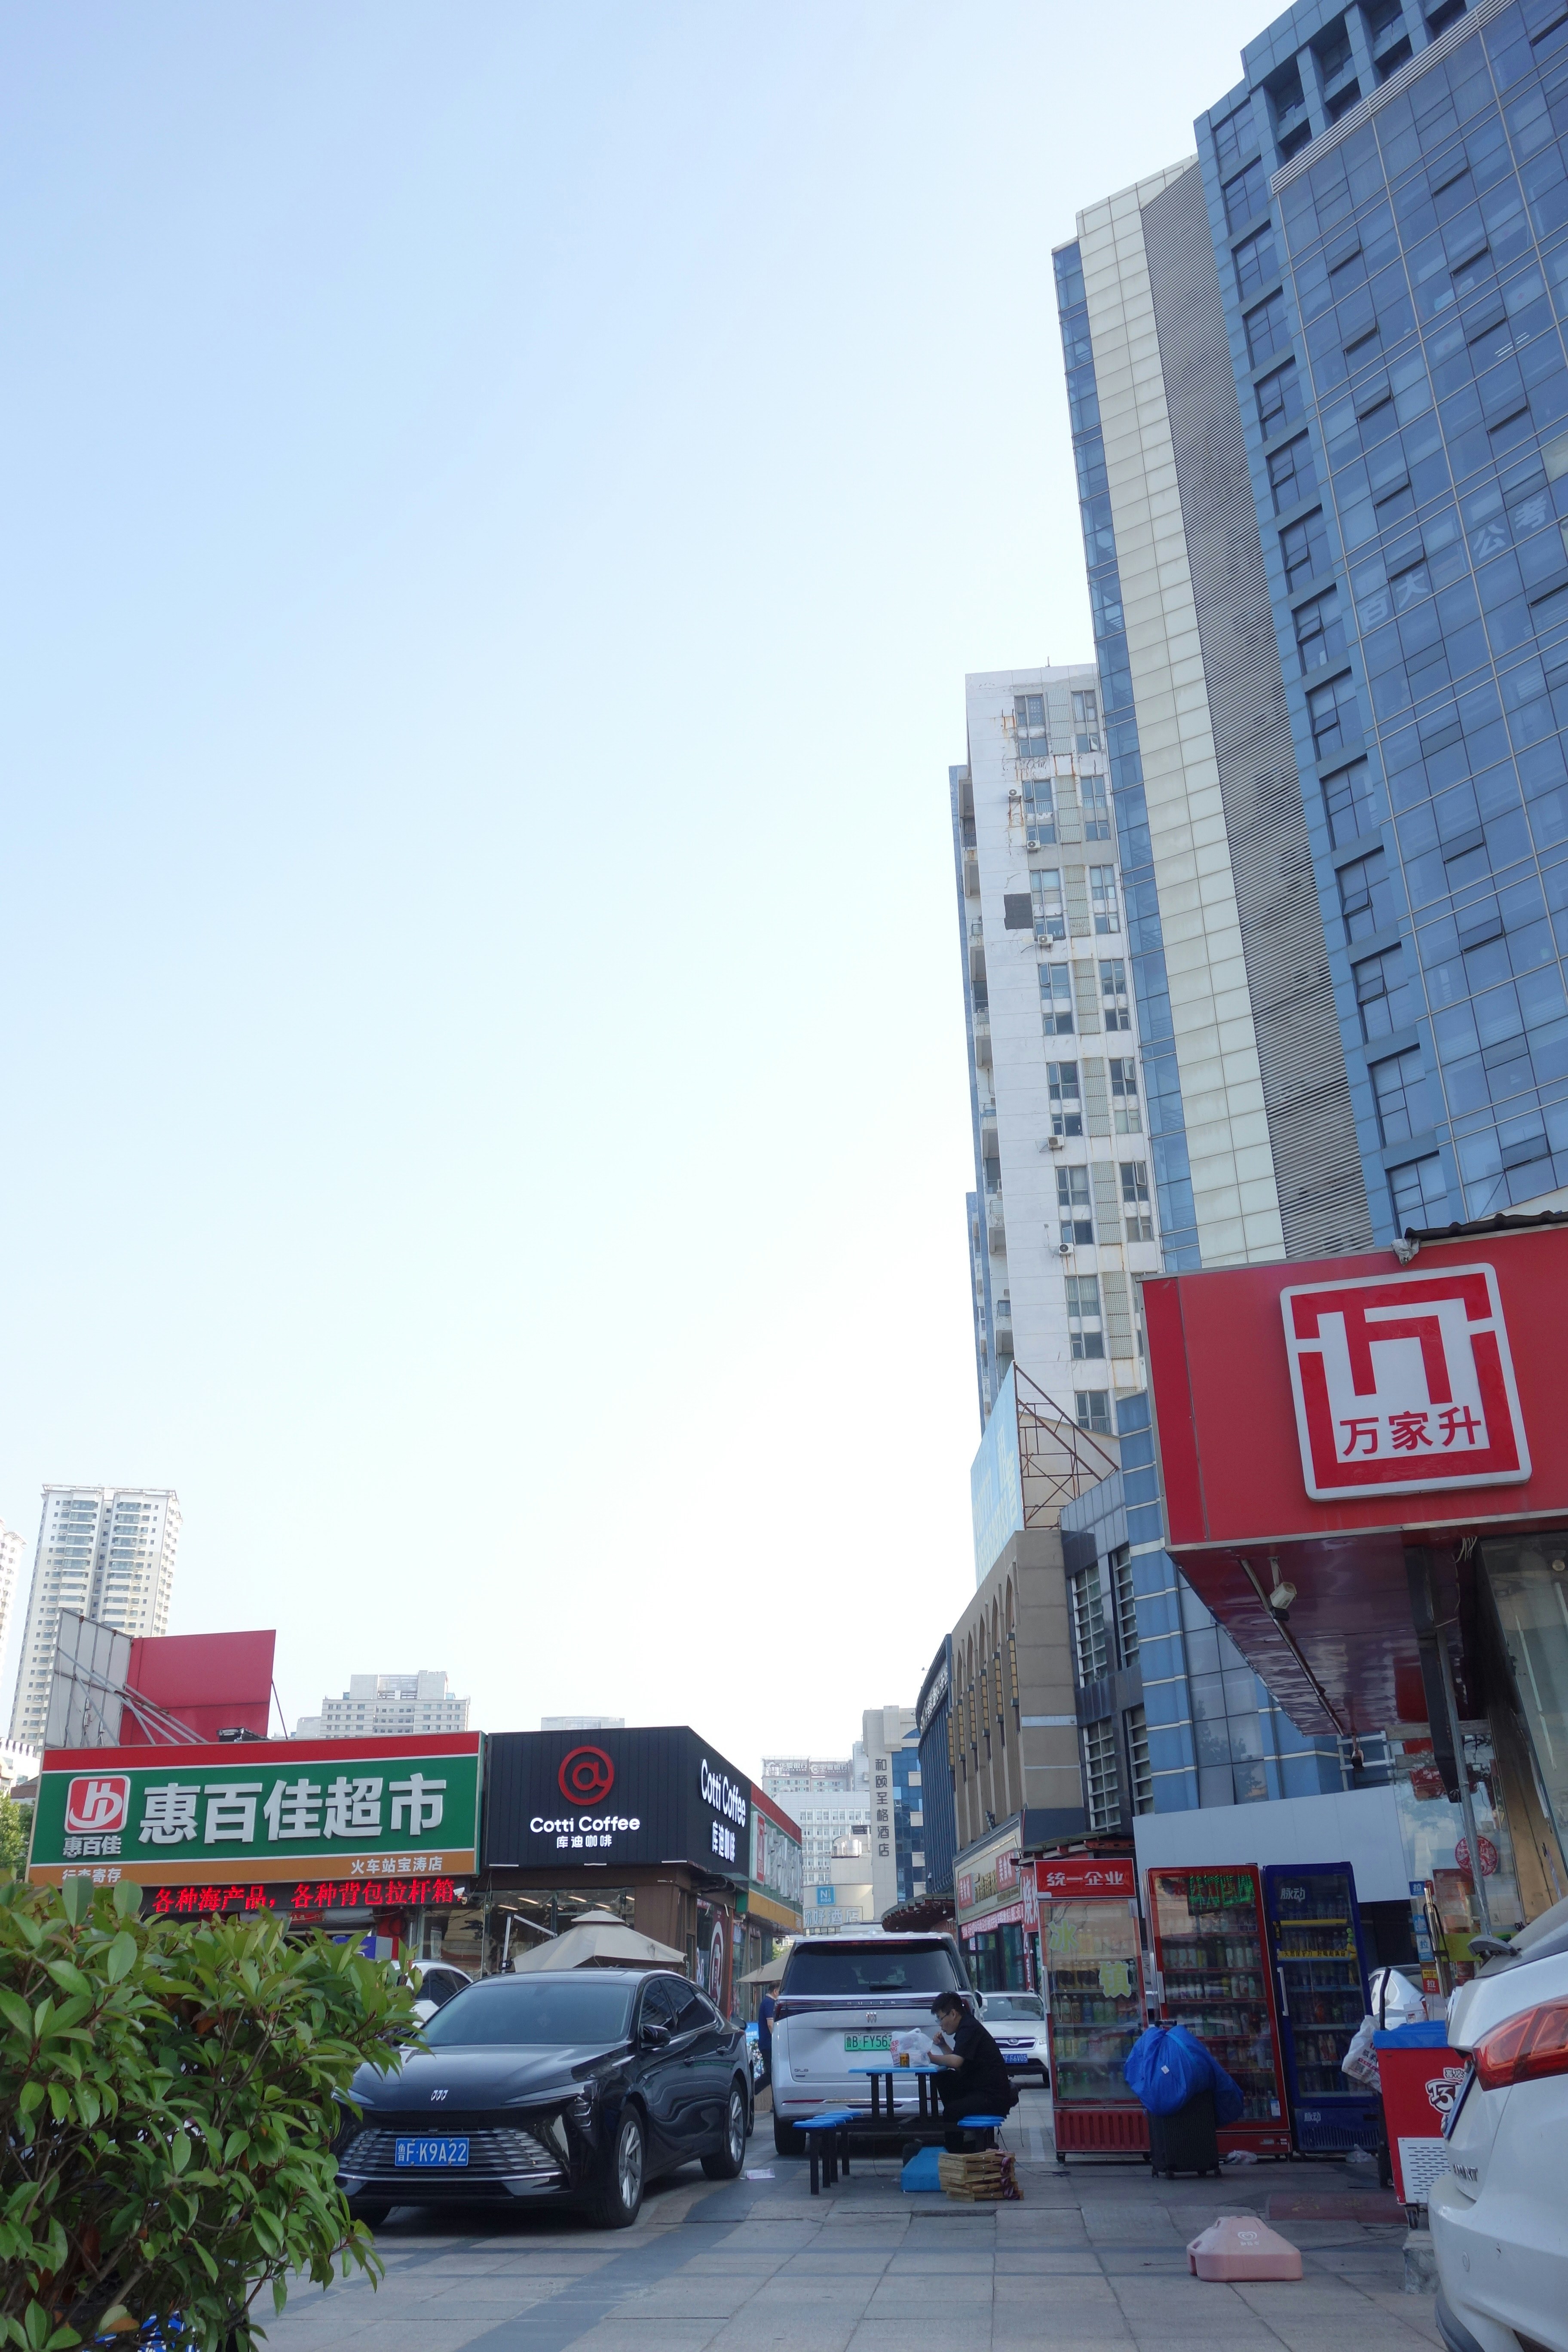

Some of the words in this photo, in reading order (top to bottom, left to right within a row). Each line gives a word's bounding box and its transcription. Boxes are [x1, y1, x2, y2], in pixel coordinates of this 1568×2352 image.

[1340, 1406, 1482, 1457] 万家升
[700, 1758, 721, 1807] Cotti
[723, 1776, 746, 1828] Coffee
[138, 1772, 447, 1844] 惠百佳超市
[875, 1758, 890, 1858] 和颐至格酒店
[530, 1817, 574, 1833] Cotti
[579, 1816, 640, 1832] Coffee
[62, 1835, 122, 1858] 惠百佳
[556, 1834, 612, 1849] 库迪咖啡
[712, 1820, 735, 1863] 库迪咖啡
[350, 1856, 443, 1875] 火车站宝涛店
[1046, 1871, 1124, 1887] 统一企业
[1280, 1886, 1306, 1902] 脉动
[804, 1908, 860, 1926] 你好酒店
[1048, 1919, 1079, 1954] 冰
[1420, 1940, 1428, 1949] 拉
[1427, 1979, 1436, 1988] 拉
